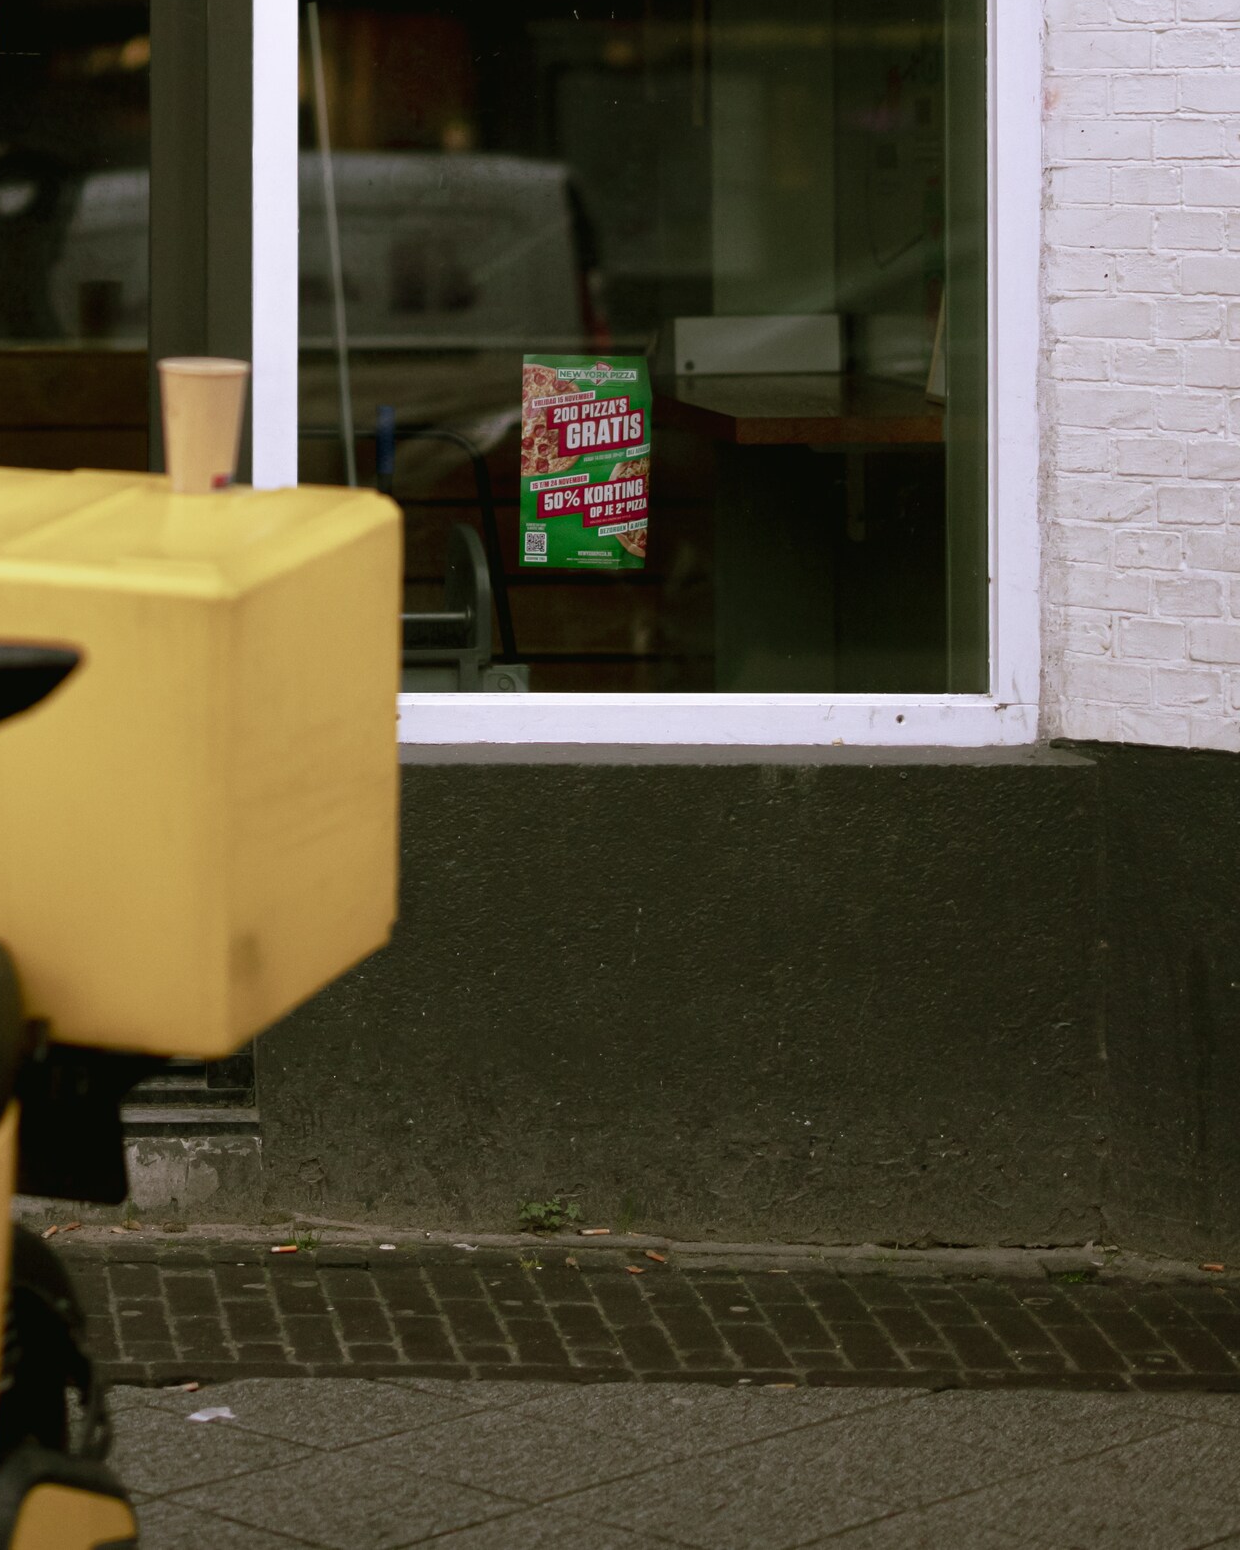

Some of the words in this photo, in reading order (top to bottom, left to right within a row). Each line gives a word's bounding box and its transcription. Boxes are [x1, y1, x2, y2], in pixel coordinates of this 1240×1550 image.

[559, 370, 582, 378] NEW
[583, 371, 609, 379] YORK
[610, 371, 635, 379] PIZZA
[534, 398, 556, 407] VRIJDAG
[564, 392, 594, 402] NOVEMBER
[553, 405, 578, 423] 200
[581, 398, 627, 419] PIZZA'S
[566, 413, 641, 449] GRATIS
[558, 475, 588, 485] NOVEMBER
[544, 488, 580, 511] 50%
[583, 478, 643, 505] KORTING
[589, 506, 603, 518] OP
[604, 504, 614, 516] JE
[626, 497, 648, 512] PIZZA
